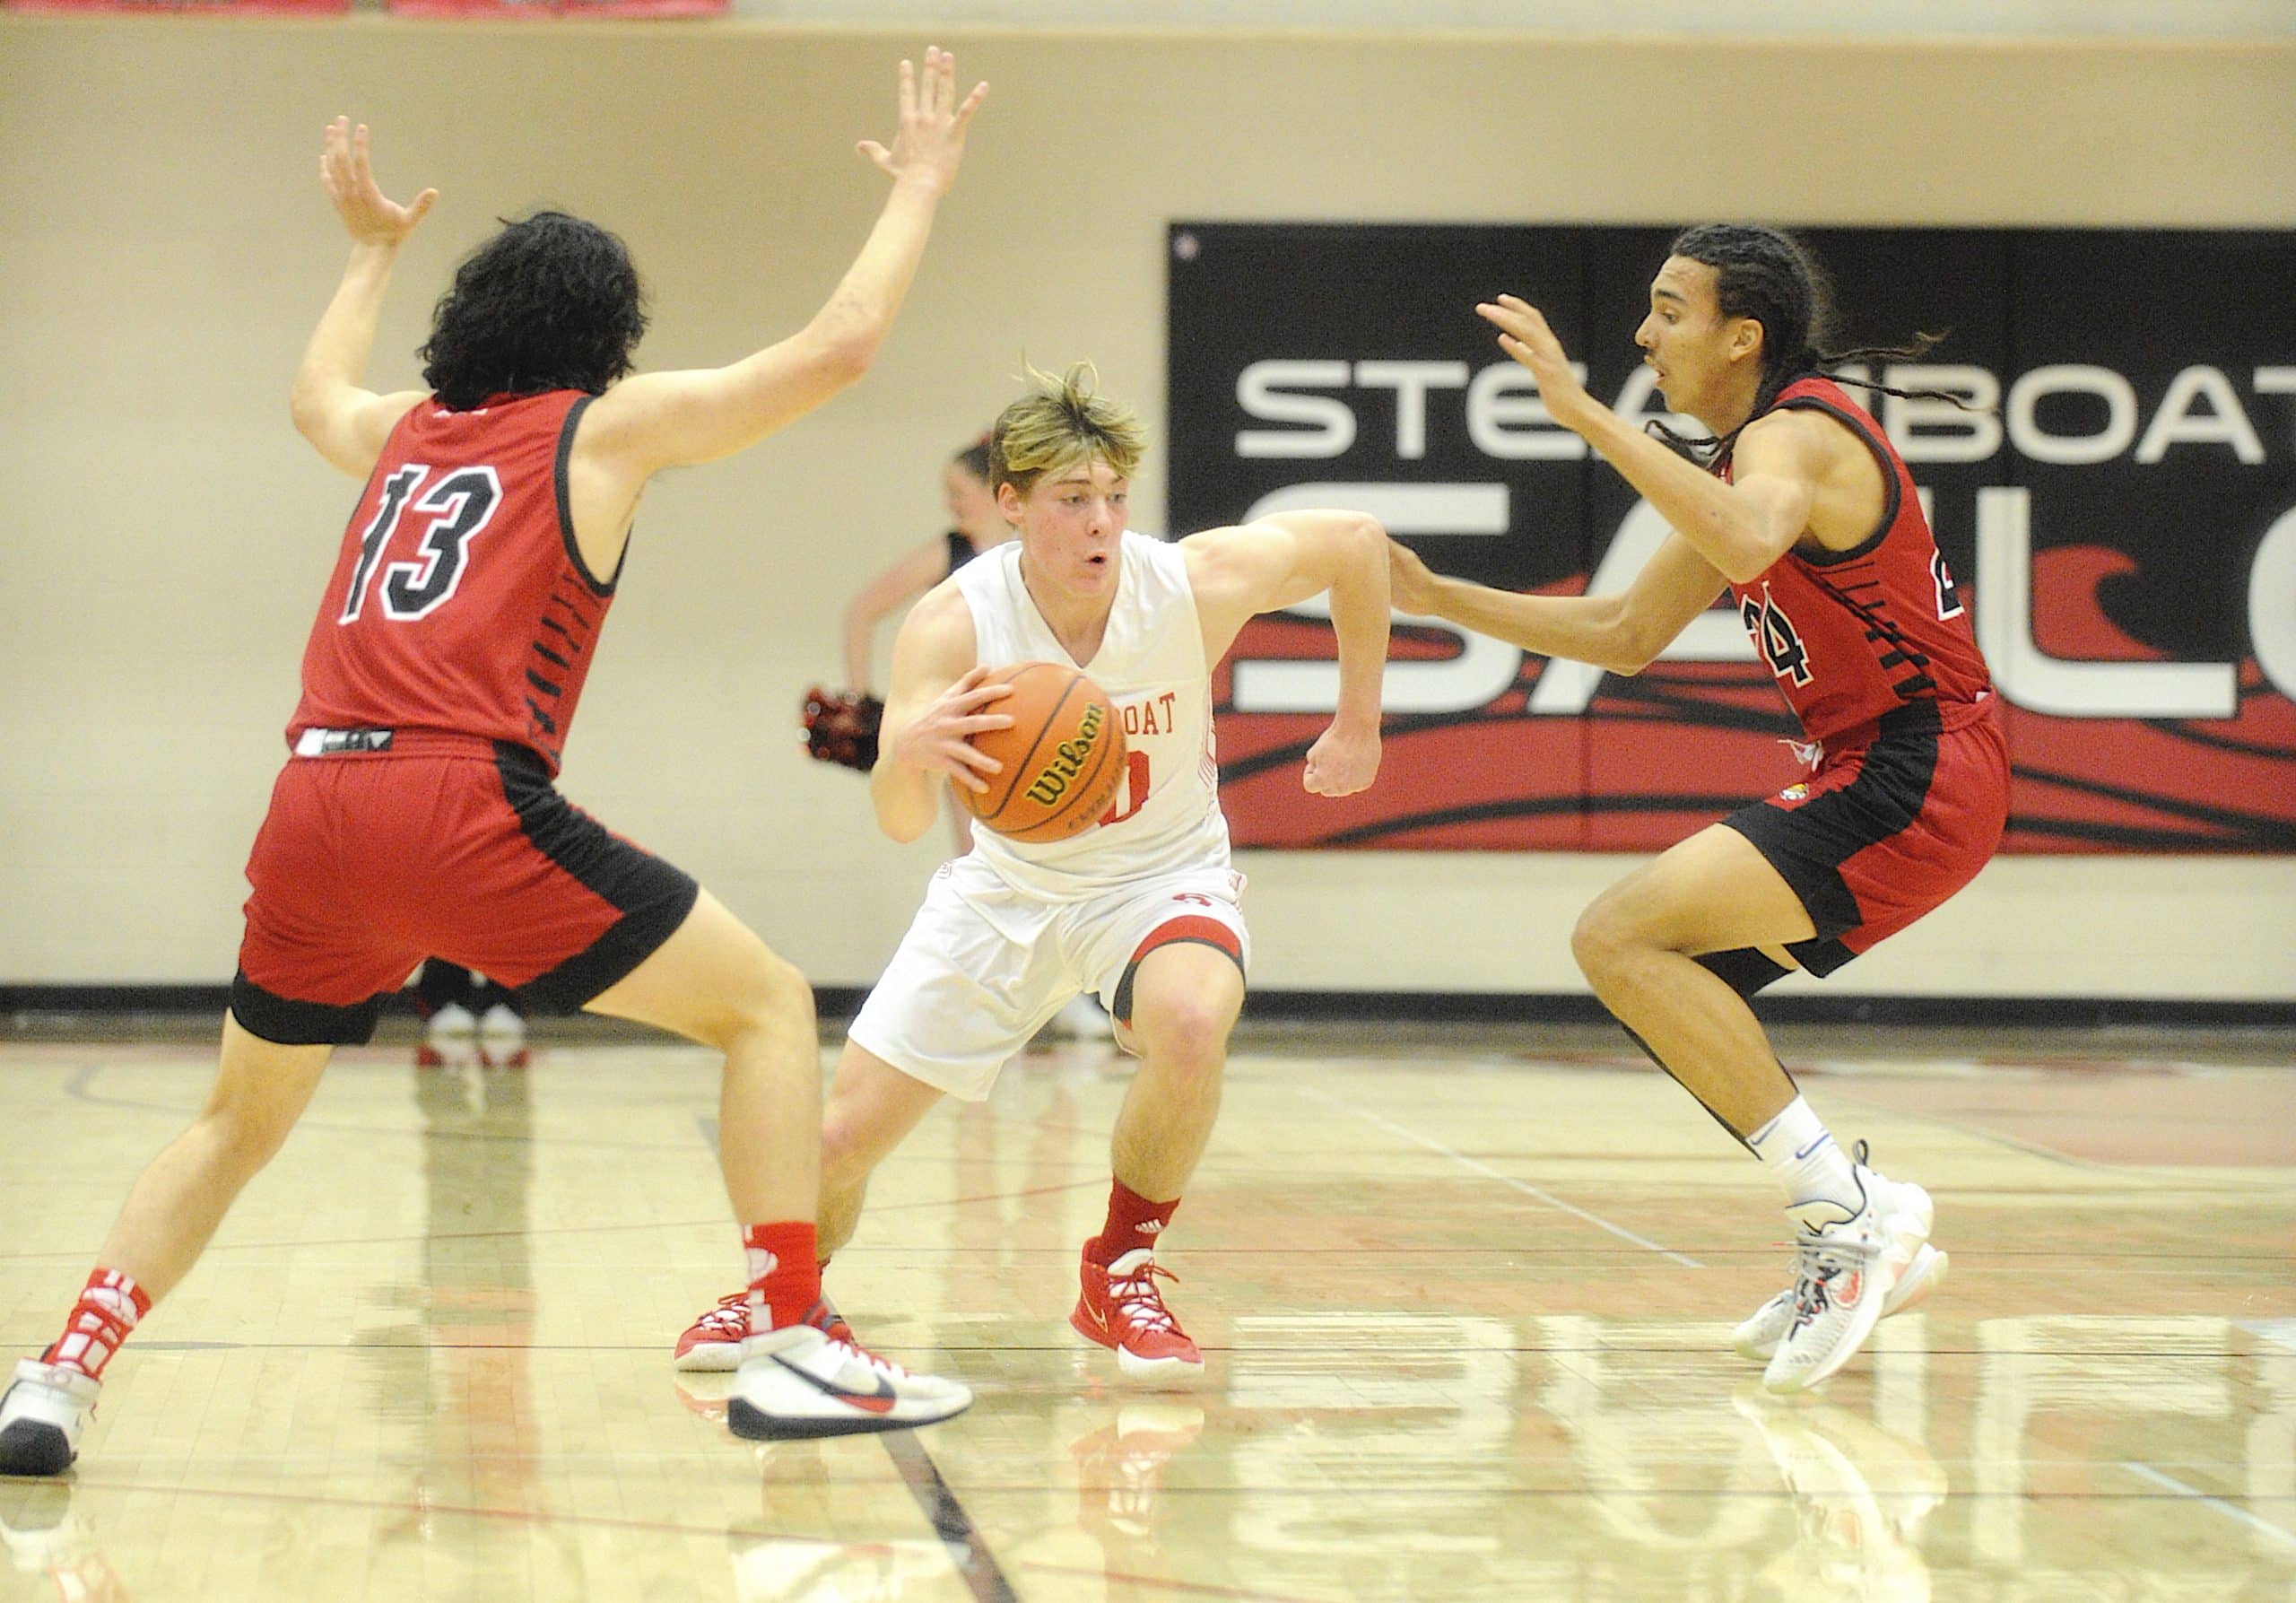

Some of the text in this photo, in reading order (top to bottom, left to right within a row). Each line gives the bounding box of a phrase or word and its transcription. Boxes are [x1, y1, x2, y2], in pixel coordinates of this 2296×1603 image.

[1235, 360, 2296, 465] STEABOA
[338, 464, 504, 626] 13
[1232, 482, 2296, 716] SAL
[1025, 702, 1105, 806] Wilson
[1123, 692, 1176, 735] OAT
